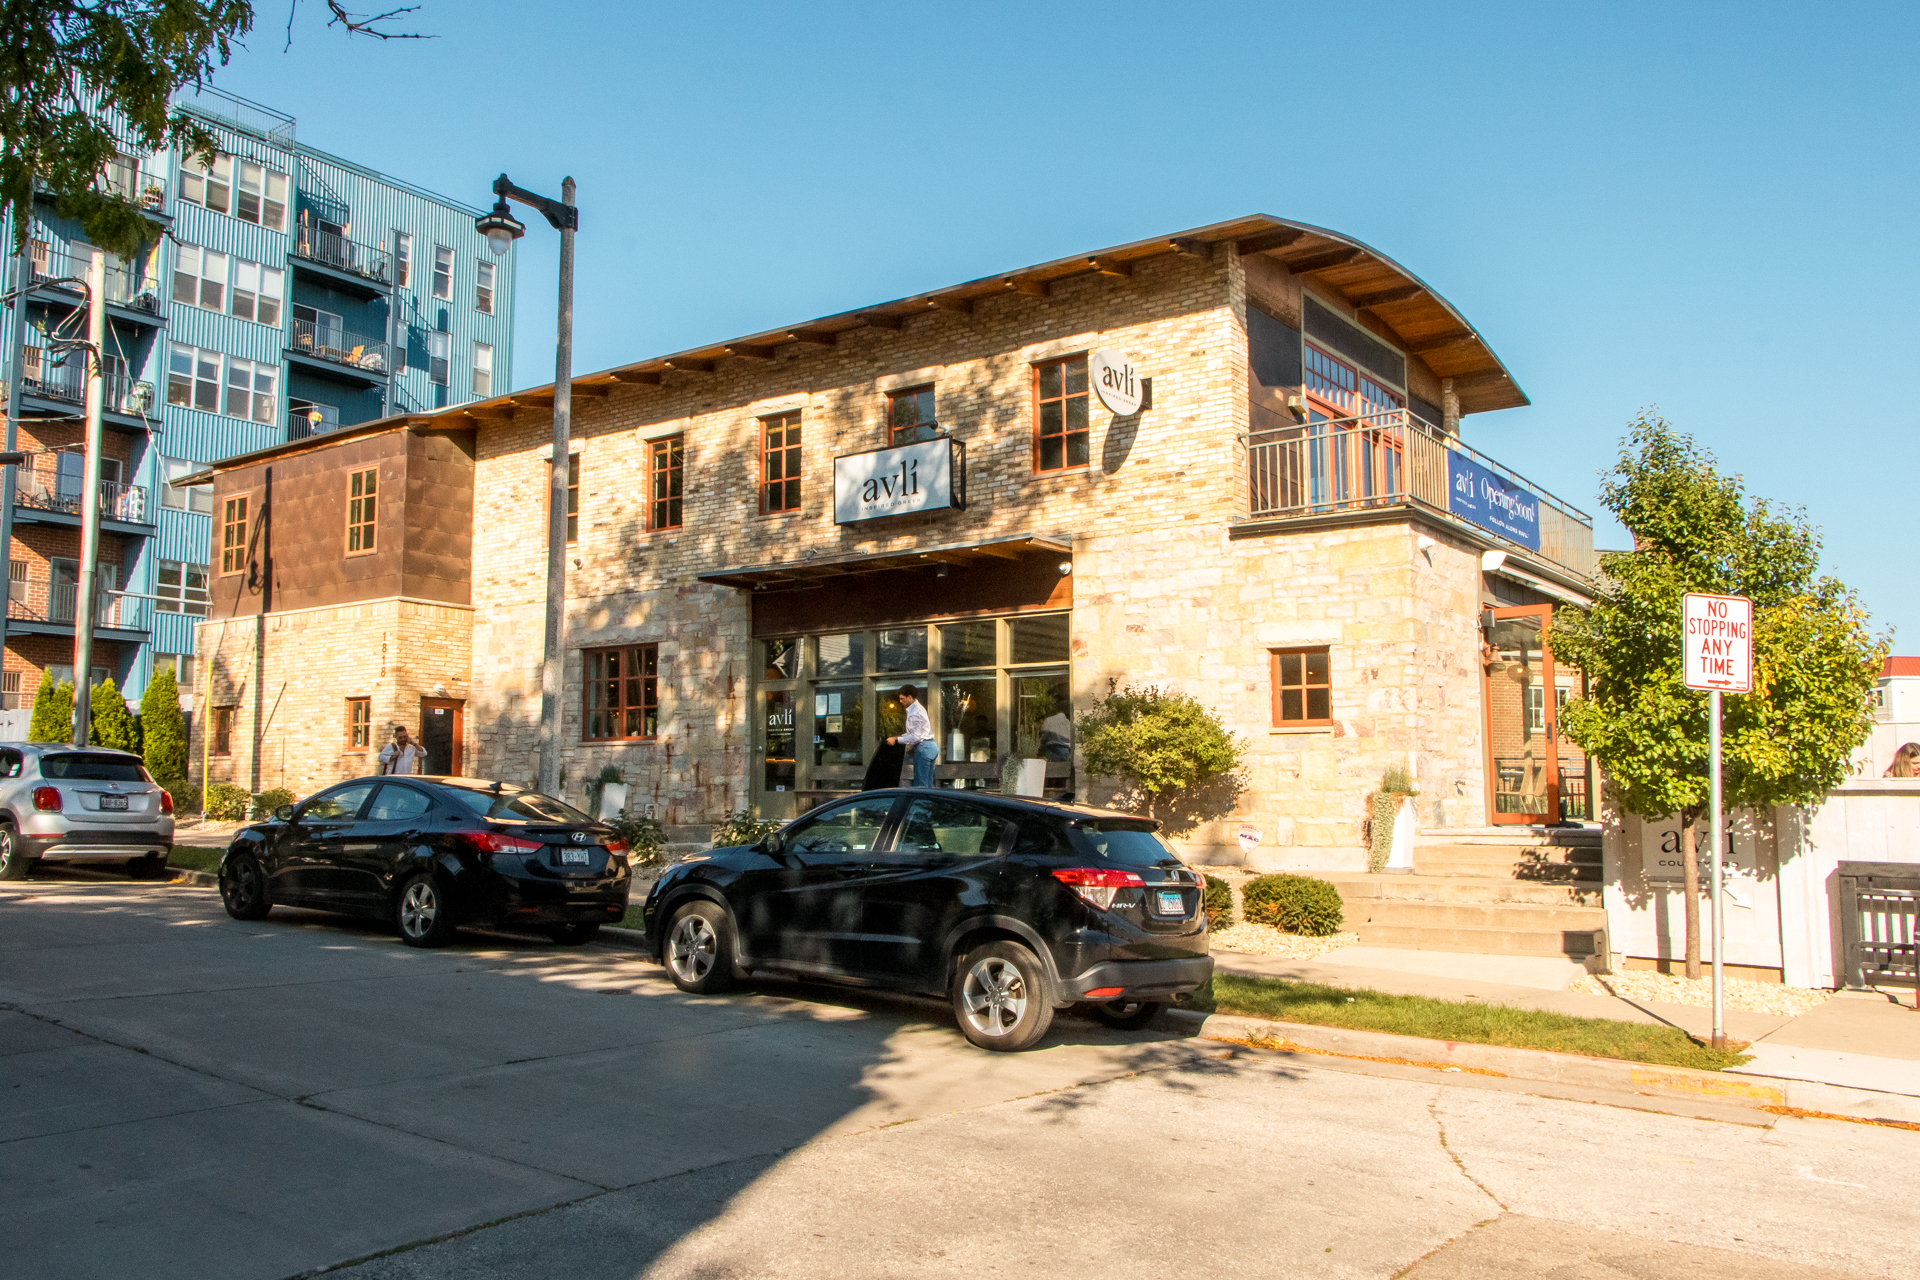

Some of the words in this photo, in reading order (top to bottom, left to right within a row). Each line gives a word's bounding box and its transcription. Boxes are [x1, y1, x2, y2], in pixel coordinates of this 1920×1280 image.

[1103, 364, 1134, 398] avlí
[862, 459, 919, 503] avlí
[862, 502, 894, 511] INSPIRED
[897, 498, 921, 506] GREEK
[1481, 477, 1515, 520] Opening
[1708, 600, 1727, 618] NO
[1689, 617, 1746, 639] STOPPING
[1702, 638, 1732, 656] ANY
[1700, 656, 1734, 676] TIME
[768, 708, 792, 726] avlí
[1661, 820, 1737, 854] aví
